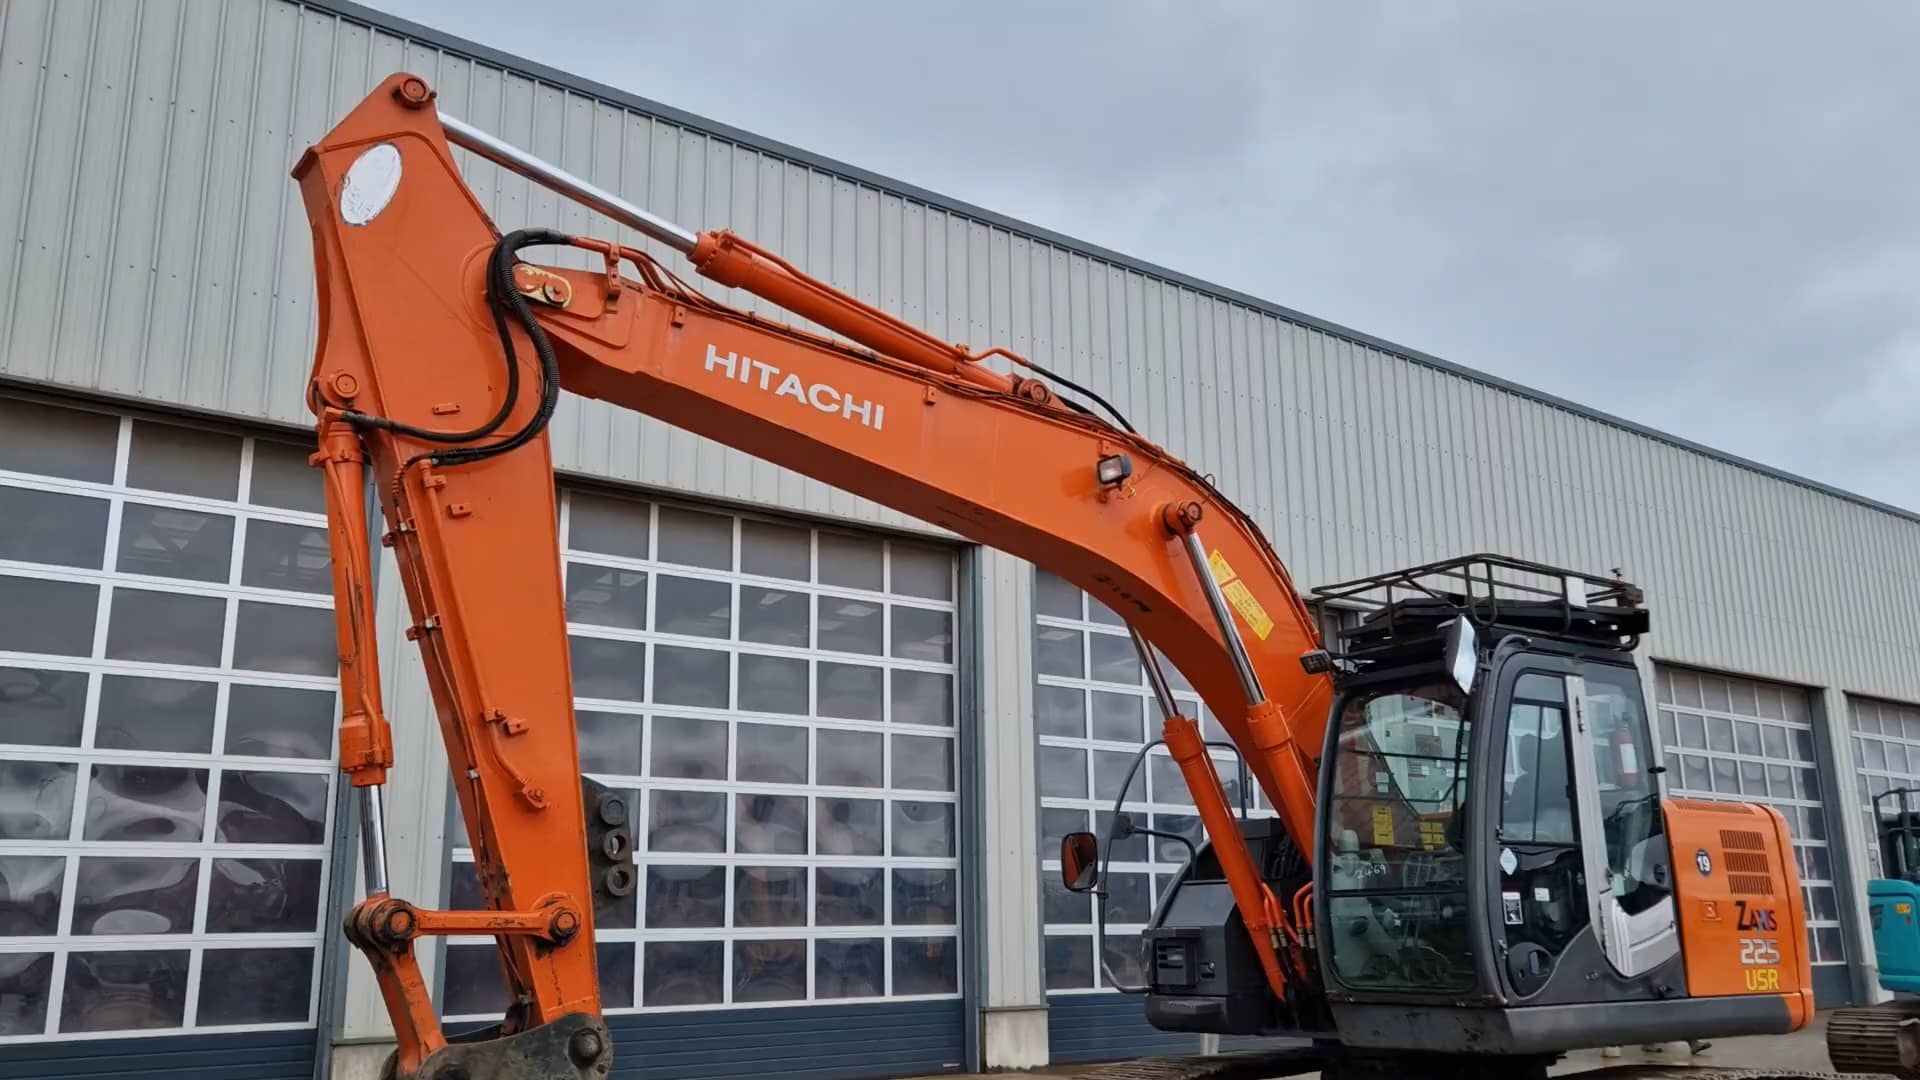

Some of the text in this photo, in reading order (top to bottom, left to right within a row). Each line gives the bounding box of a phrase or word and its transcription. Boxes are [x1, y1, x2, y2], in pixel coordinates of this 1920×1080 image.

[704, 343, 885, 431] HITACHI
[1697, 855, 1711, 873] 19
[1739, 938, 1781, 965] 225
[1744, 968, 1780, 991] USR
